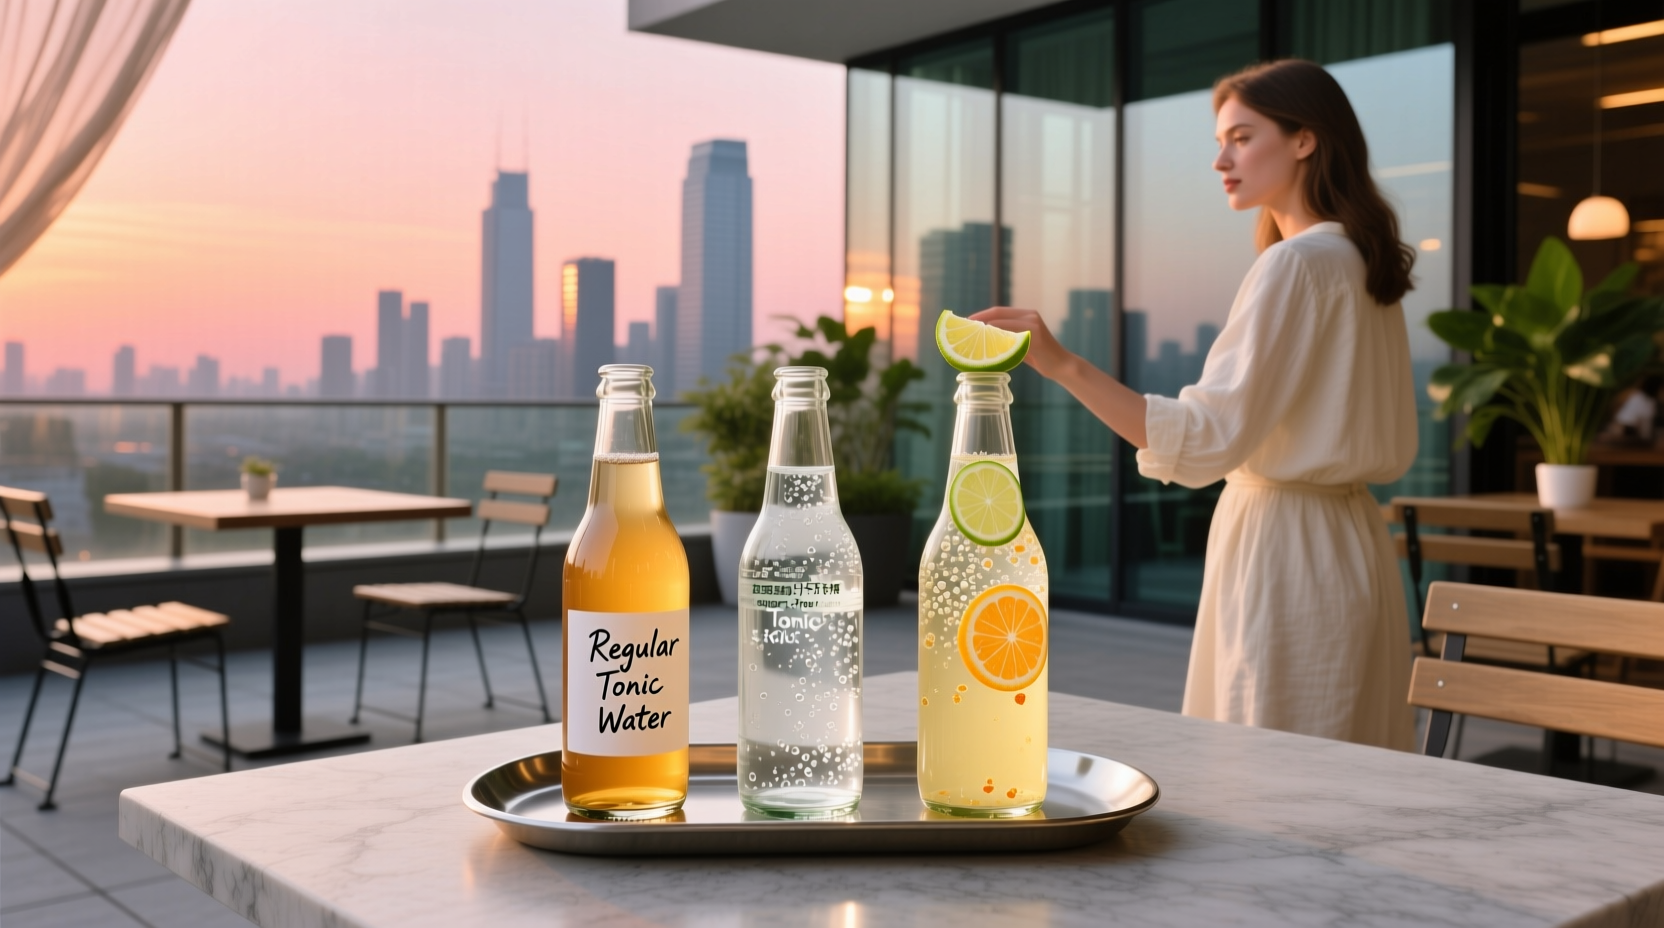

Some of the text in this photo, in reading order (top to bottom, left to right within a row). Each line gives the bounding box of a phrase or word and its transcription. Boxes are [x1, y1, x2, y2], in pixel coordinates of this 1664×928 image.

[589, 628, 680, 673] Regular
[596, 669, 664, 700] Tonic
[599, 704, 672, 734] Water
